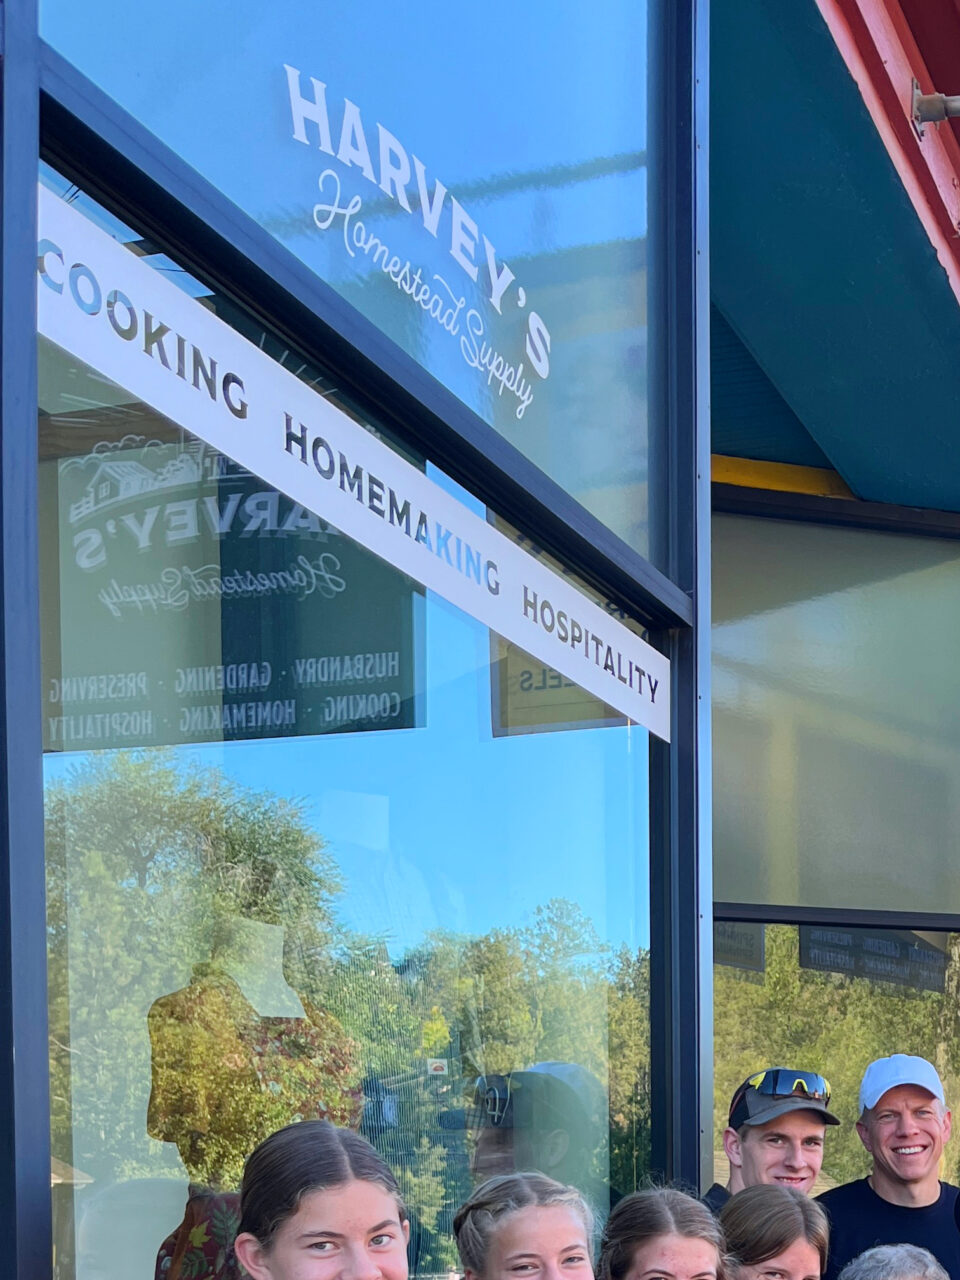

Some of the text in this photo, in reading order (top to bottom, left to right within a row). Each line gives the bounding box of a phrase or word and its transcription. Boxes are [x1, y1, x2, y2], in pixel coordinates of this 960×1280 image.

[284, 63, 550, 379] HARVEY'S
[313, 168, 533, 420] Homestead Supply
[38, 238, 659, 703] COOKING HOMEMAKING HOSPITALITY
